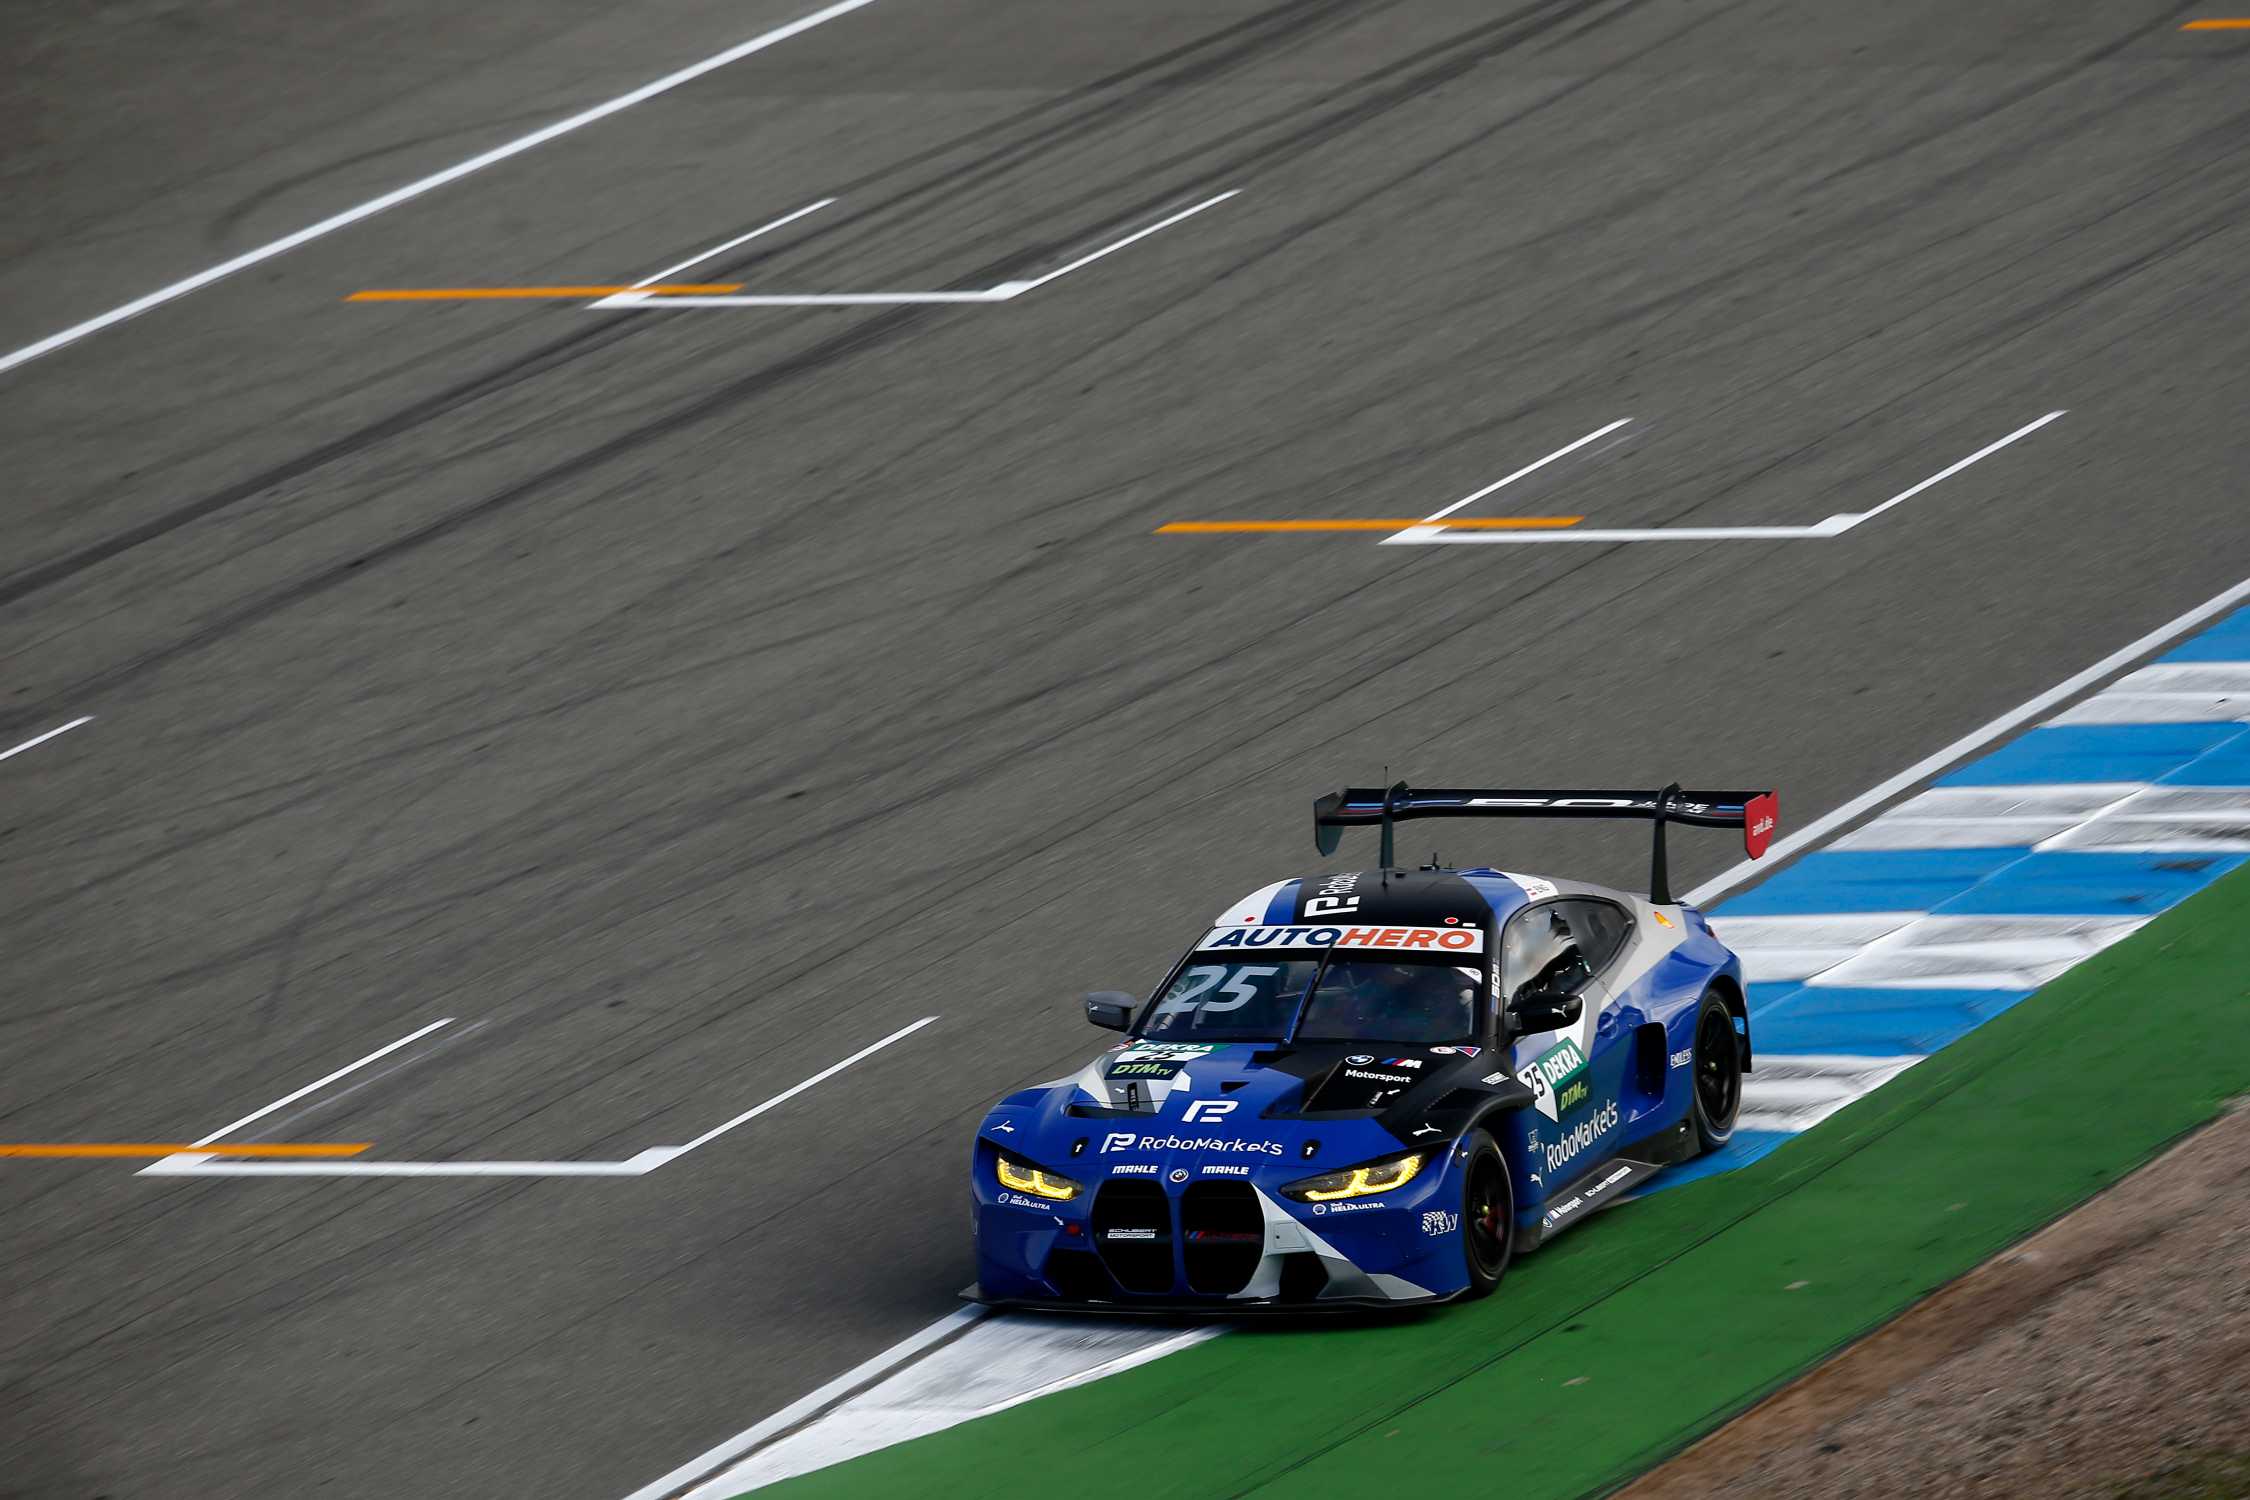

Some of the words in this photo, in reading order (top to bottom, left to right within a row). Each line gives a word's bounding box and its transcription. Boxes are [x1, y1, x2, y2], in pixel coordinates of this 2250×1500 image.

[1209, 928, 1475, 949] AUTOHERO
[1153, 965, 1280, 1014] 25
[1134, 1043, 1214, 1052] DEKRA
[1134, 1051, 1176, 1061] 25
[1543, 1044, 1583, 1084] DEKRA
[1345, 1069, 1412, 1083] Motorsport
[1547, 1099, 1618, 1173] RoboMarkets
[1138, 1134, 1284, 1156] RoboMarkets
[1112, 1165, 1159, 1174] MAHLE
[1202, 1165, 1250, 1175] MAHLE
